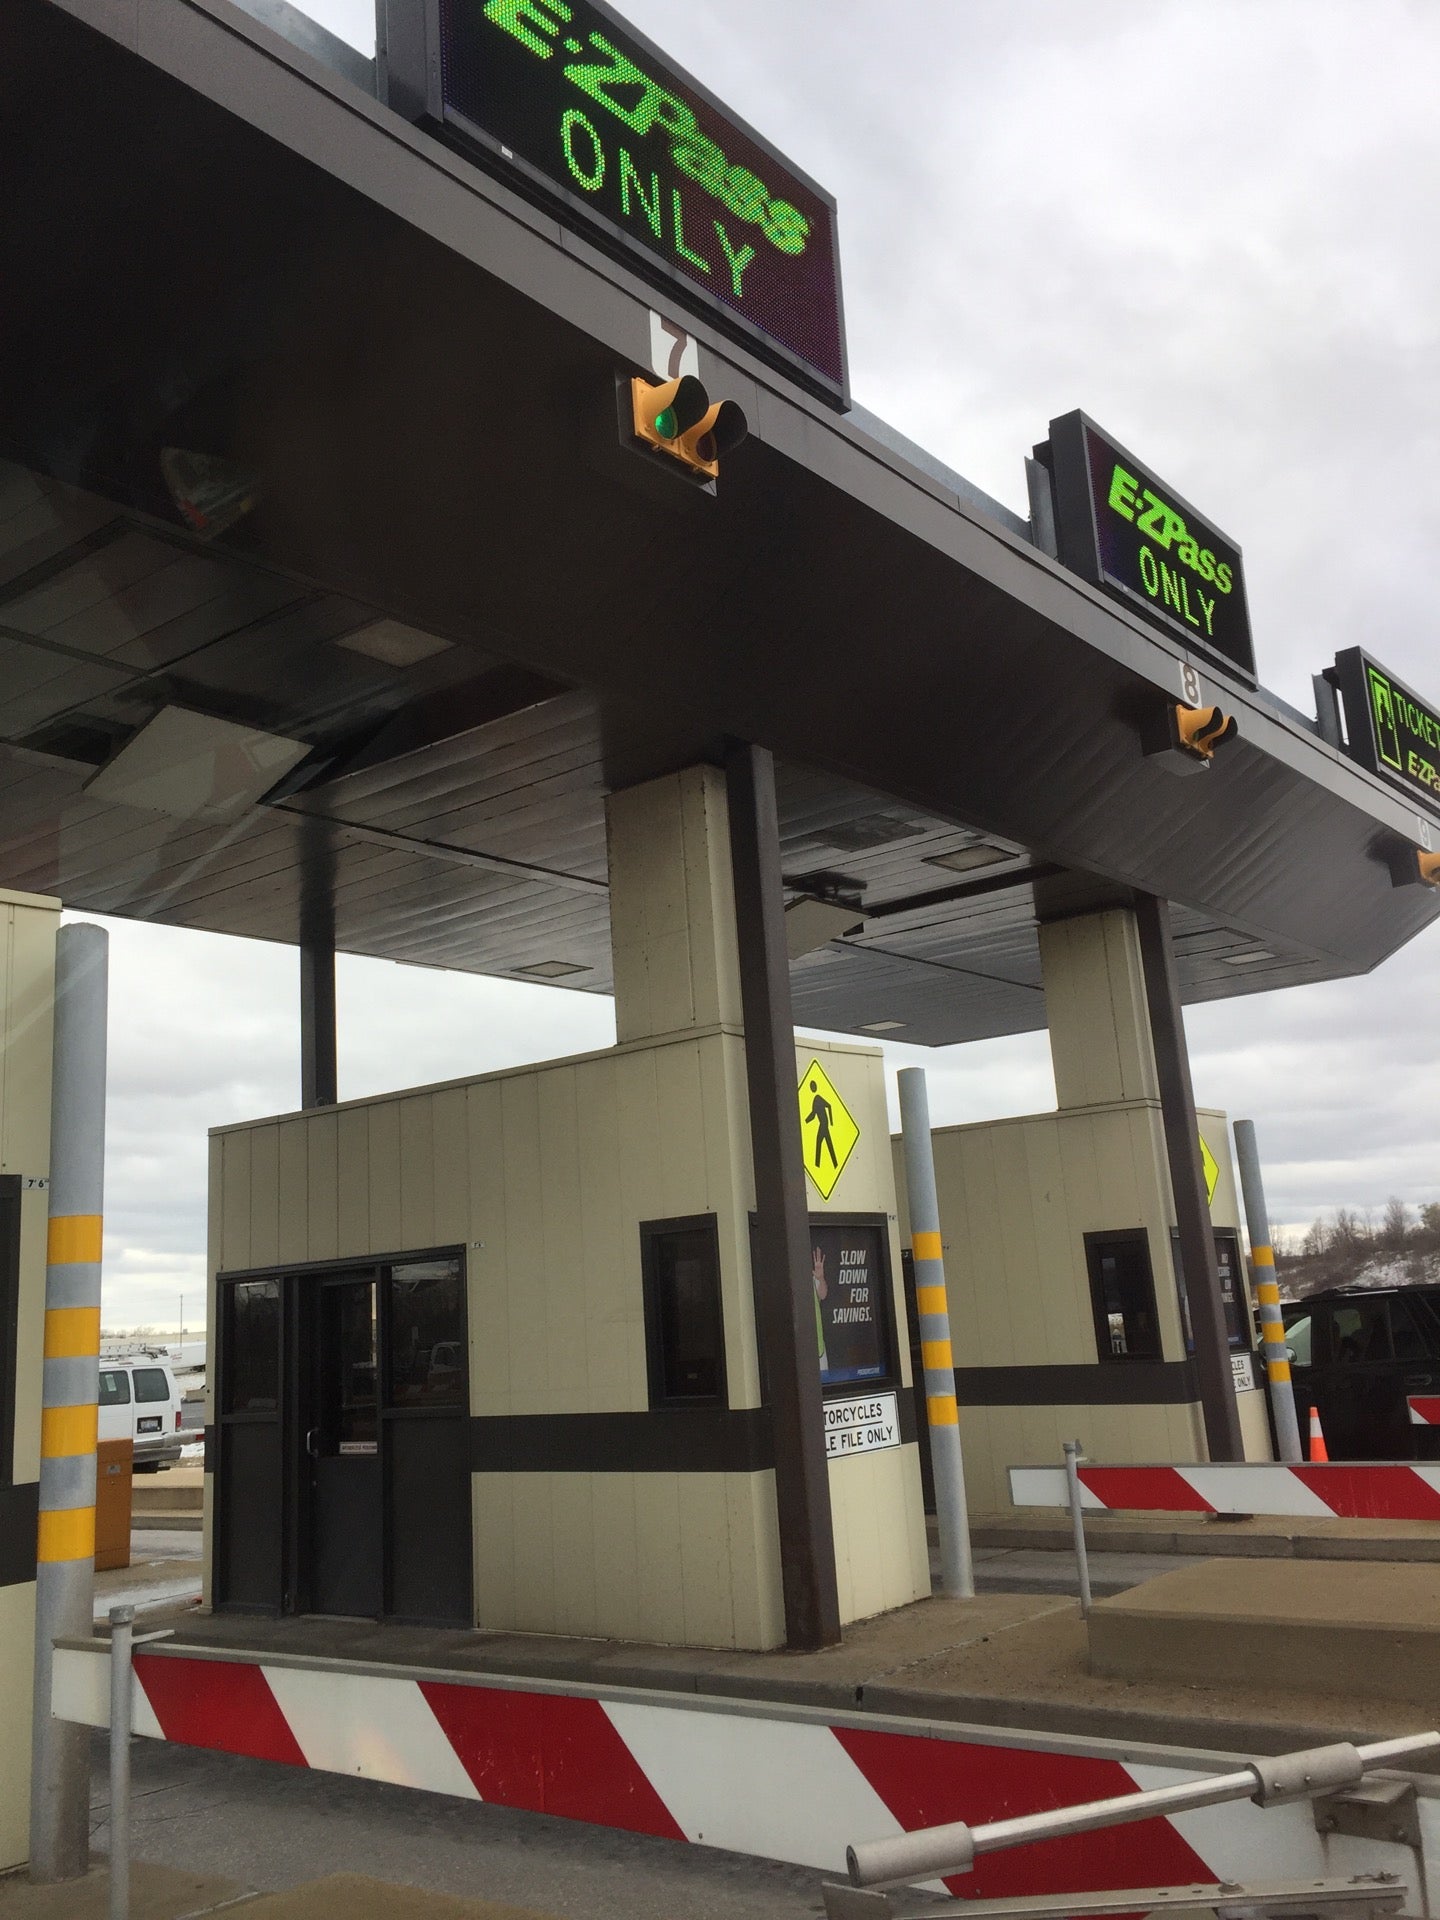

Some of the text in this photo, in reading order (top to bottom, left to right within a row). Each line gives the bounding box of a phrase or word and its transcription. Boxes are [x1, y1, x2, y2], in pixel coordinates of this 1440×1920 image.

[560, 108, 755, 297] ONLY
[660, 315, 687, 379] 7
[1139, 545, 1215, 635] ONLY
[1183, 664, 1199, 704] 8
[840, 1250, 866, 1265] SLOW
[838, 1269, 867, 1284] DOWN
[850, 1288, 869, 1303] FOR
[832, 1307, 872, 1324] SAVINGS.
[841, 1431, 863, 1448] FILE
[867, 1426, 893, 1444] ONLY
